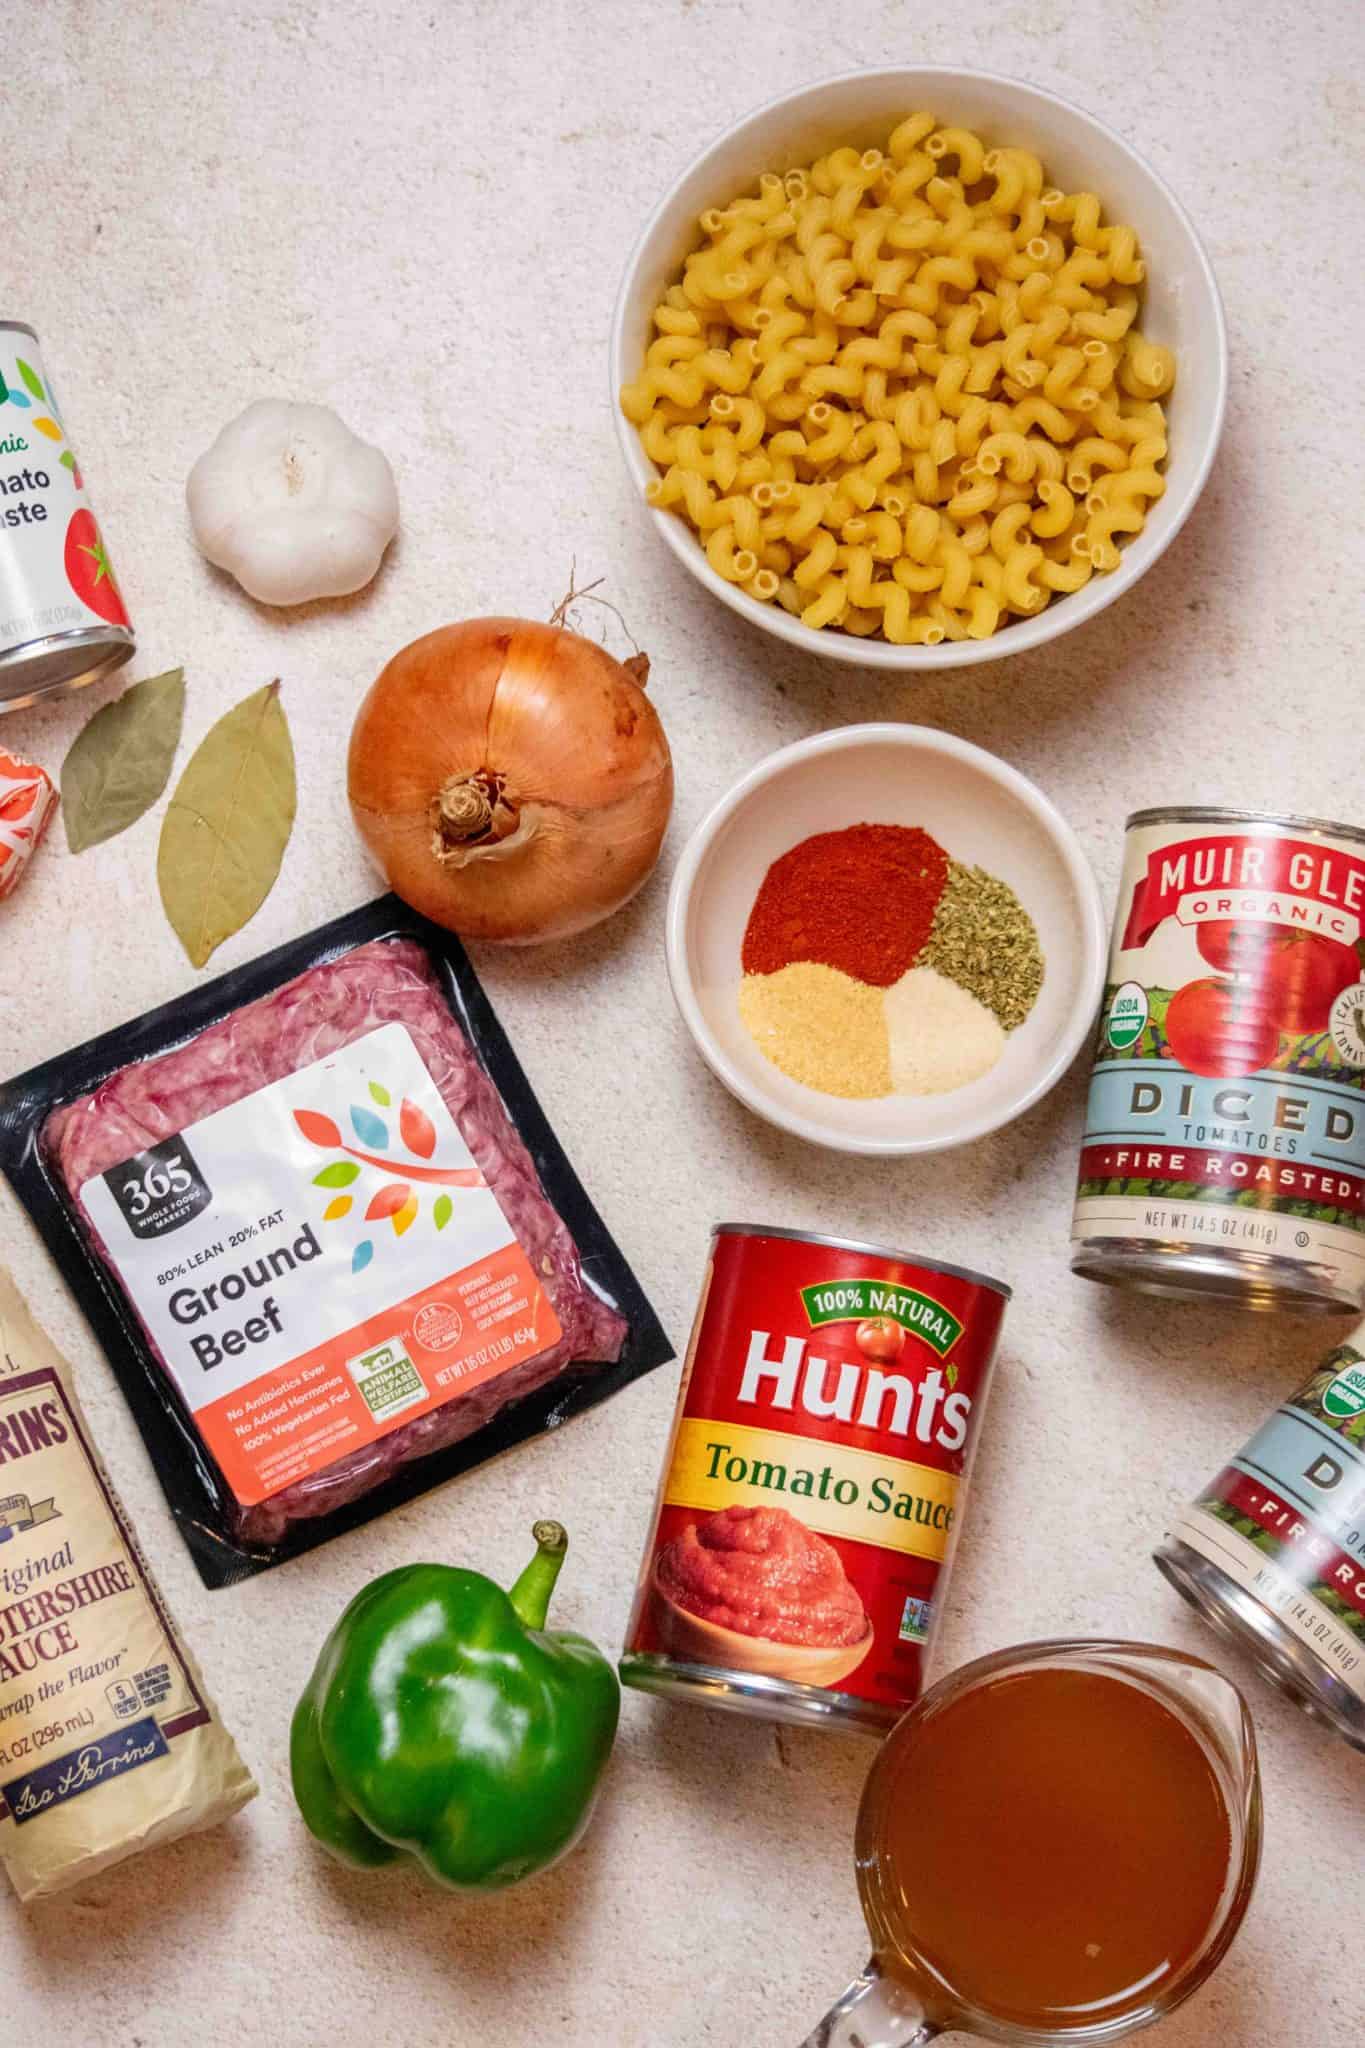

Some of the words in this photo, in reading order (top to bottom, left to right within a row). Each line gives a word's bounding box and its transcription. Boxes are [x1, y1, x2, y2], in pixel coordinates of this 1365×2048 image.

[1160, 847, 1265, 896] MUIR
[1289, 853, 1365, 911] GLE
[1192, 899, 1346, 934] ORGANIC
[1115, 998, 1138, 1013] USDA
[1129, 1082, 1355, 1142] DICED
[1183, 1124, 1298, 1155] TOMATOES
[122, 1155, 193, 1216] 365
[1116, 1151, 1185, 1170] FIRE
[1205, 1157, 1351, 1198] ROASTED
[138, 1206, 170, 1228] WHOLE
[170, 1191, 201, 1209] FOODS
[155, 1205, 193, 1229] MARKET
[1144, 1211, 1167, 1226] NET
[1171, 1212, 1188, 1228] WT
[1191, 1215, 1216, 1232] 14.5
[1222, 1218, 1238, 1235] OZ
[156, 1264, 187, 1286] 80%
[186, 1242, 225, 1269] LEAN
[228, 1226, 259, 1248] 20%
[258, 1209, 286, 1232] FAT
[169, 1222, 323, 1325] Ground
[190, 1297, 284, 1372] Beef
[812, 1288, 863, 1313] 100%
[869, 1288, 952, 1345] NATURAL
[227, 1408, 244, 1422] No
[245, 1378, 301, 1412] Antibiotics
[301, 1364, 326, 1382] Ever
[364, 1362, 409, 1392] ANIMAL
[235, 1423, 252, 1437] No
[253, 1402, 288, 1428] Added
[288, 1376, 343, 1408] Hormones
[243, 1432, 272, 1452] 100%
[272, 1402, 330, 1435] Vegetarian
[330, 1388, 351, 1407] Fed
[704, 1443, 859, 1505] Tomato
[867, 1477, 954, 1532] Sauce
[0, 1541, 74, 1596] iginal
[1291, 1603, 1317, 1629] 14.5
[1313, 1623, 1331, 1642] OZ
[37, 1682, 64, 1702] the
[115, 1685, 126, 1699] 5
[11, 1735, 33, 1758] OZ
[32, 1721, 64, 1750] (296
[66, 1707, 94, 1732] mL)
[16, 1783, 55, 1816] Lea
[72, 1739, 155, 1787] Perrins
